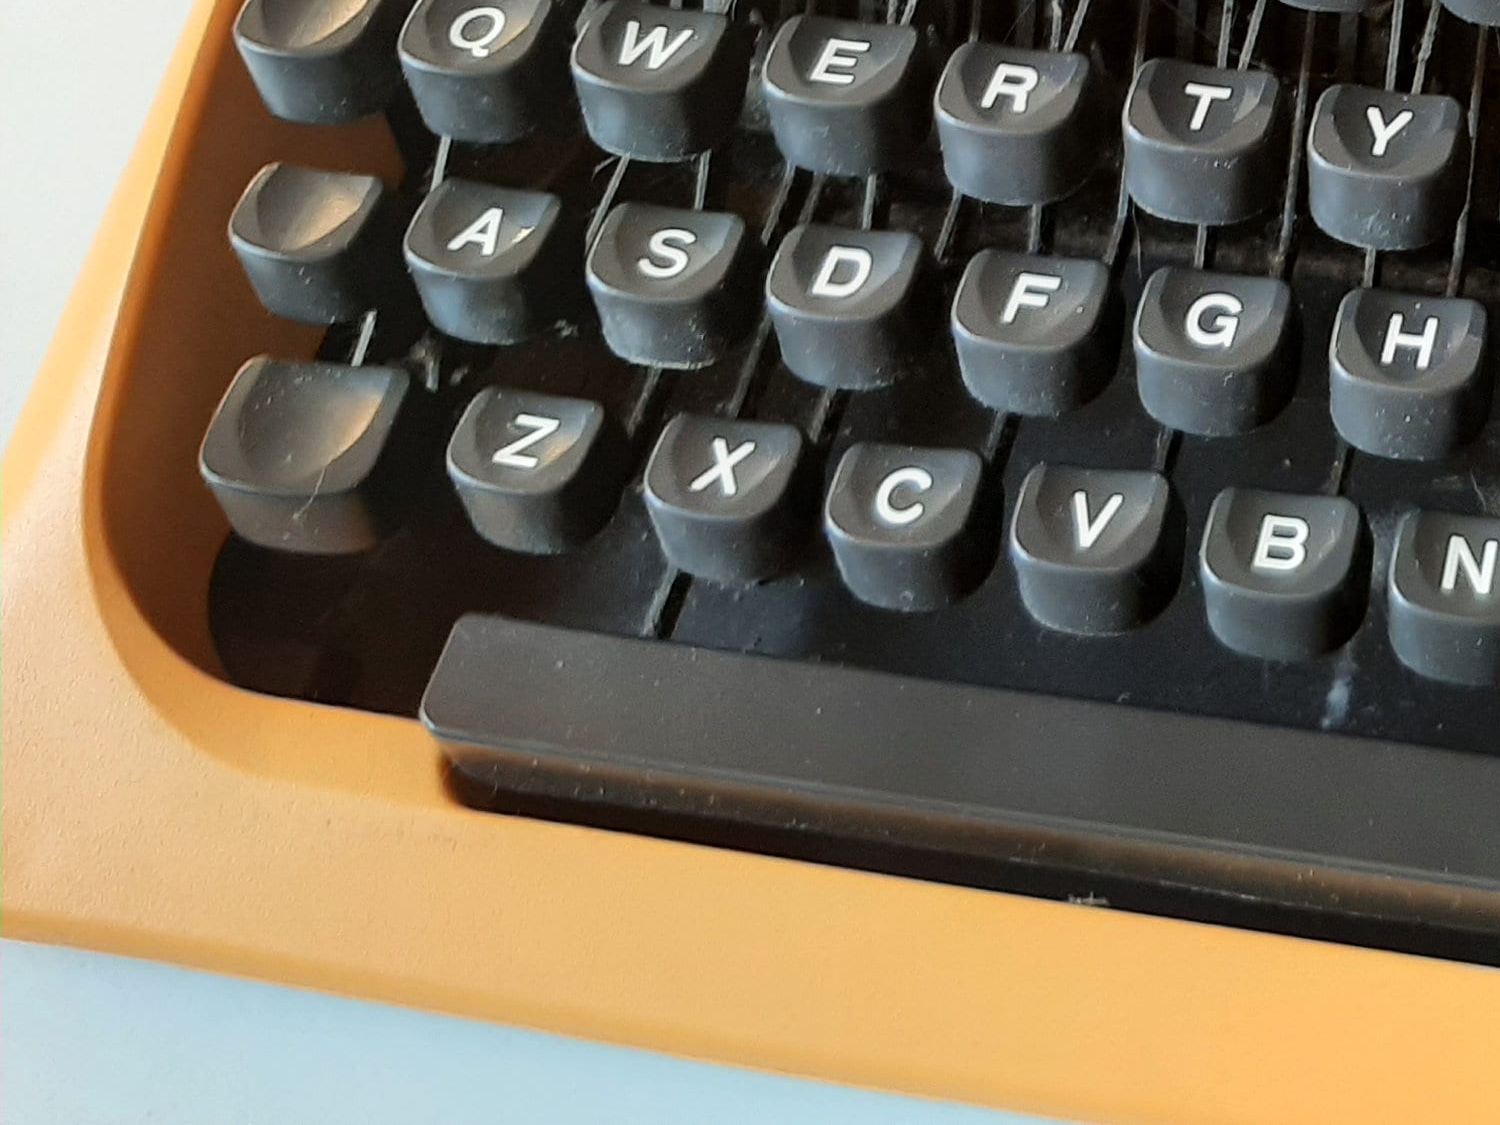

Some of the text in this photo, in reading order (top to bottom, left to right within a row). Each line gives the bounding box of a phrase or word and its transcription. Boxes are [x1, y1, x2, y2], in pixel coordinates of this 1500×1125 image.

[448, 6, 506, 58] Q
[618, 20, 694, 71] W
[809, 38, 871, 86] E
[979, 63, 1039, 114] R
[1184, 82, 1233, 131] T
[1365, 106, 1414, 157] Y
[446, 207, 505, 256] A
[636, 228, 698, 278] S
[810, 246, 873, 299] D
[1000, 272, 1062, 324] F
[1184, 292, 1244, 350] G
[1380, 312, 1439, 370] H
[490, 413, 561, 469] Z
[689, 436, 757, 497] X
[874, 466, 933, 526] C
[1072, 490, 1124, 551] V
[1251, 514, 1310, 573] B
[1440, 535, 1499, 599] N
